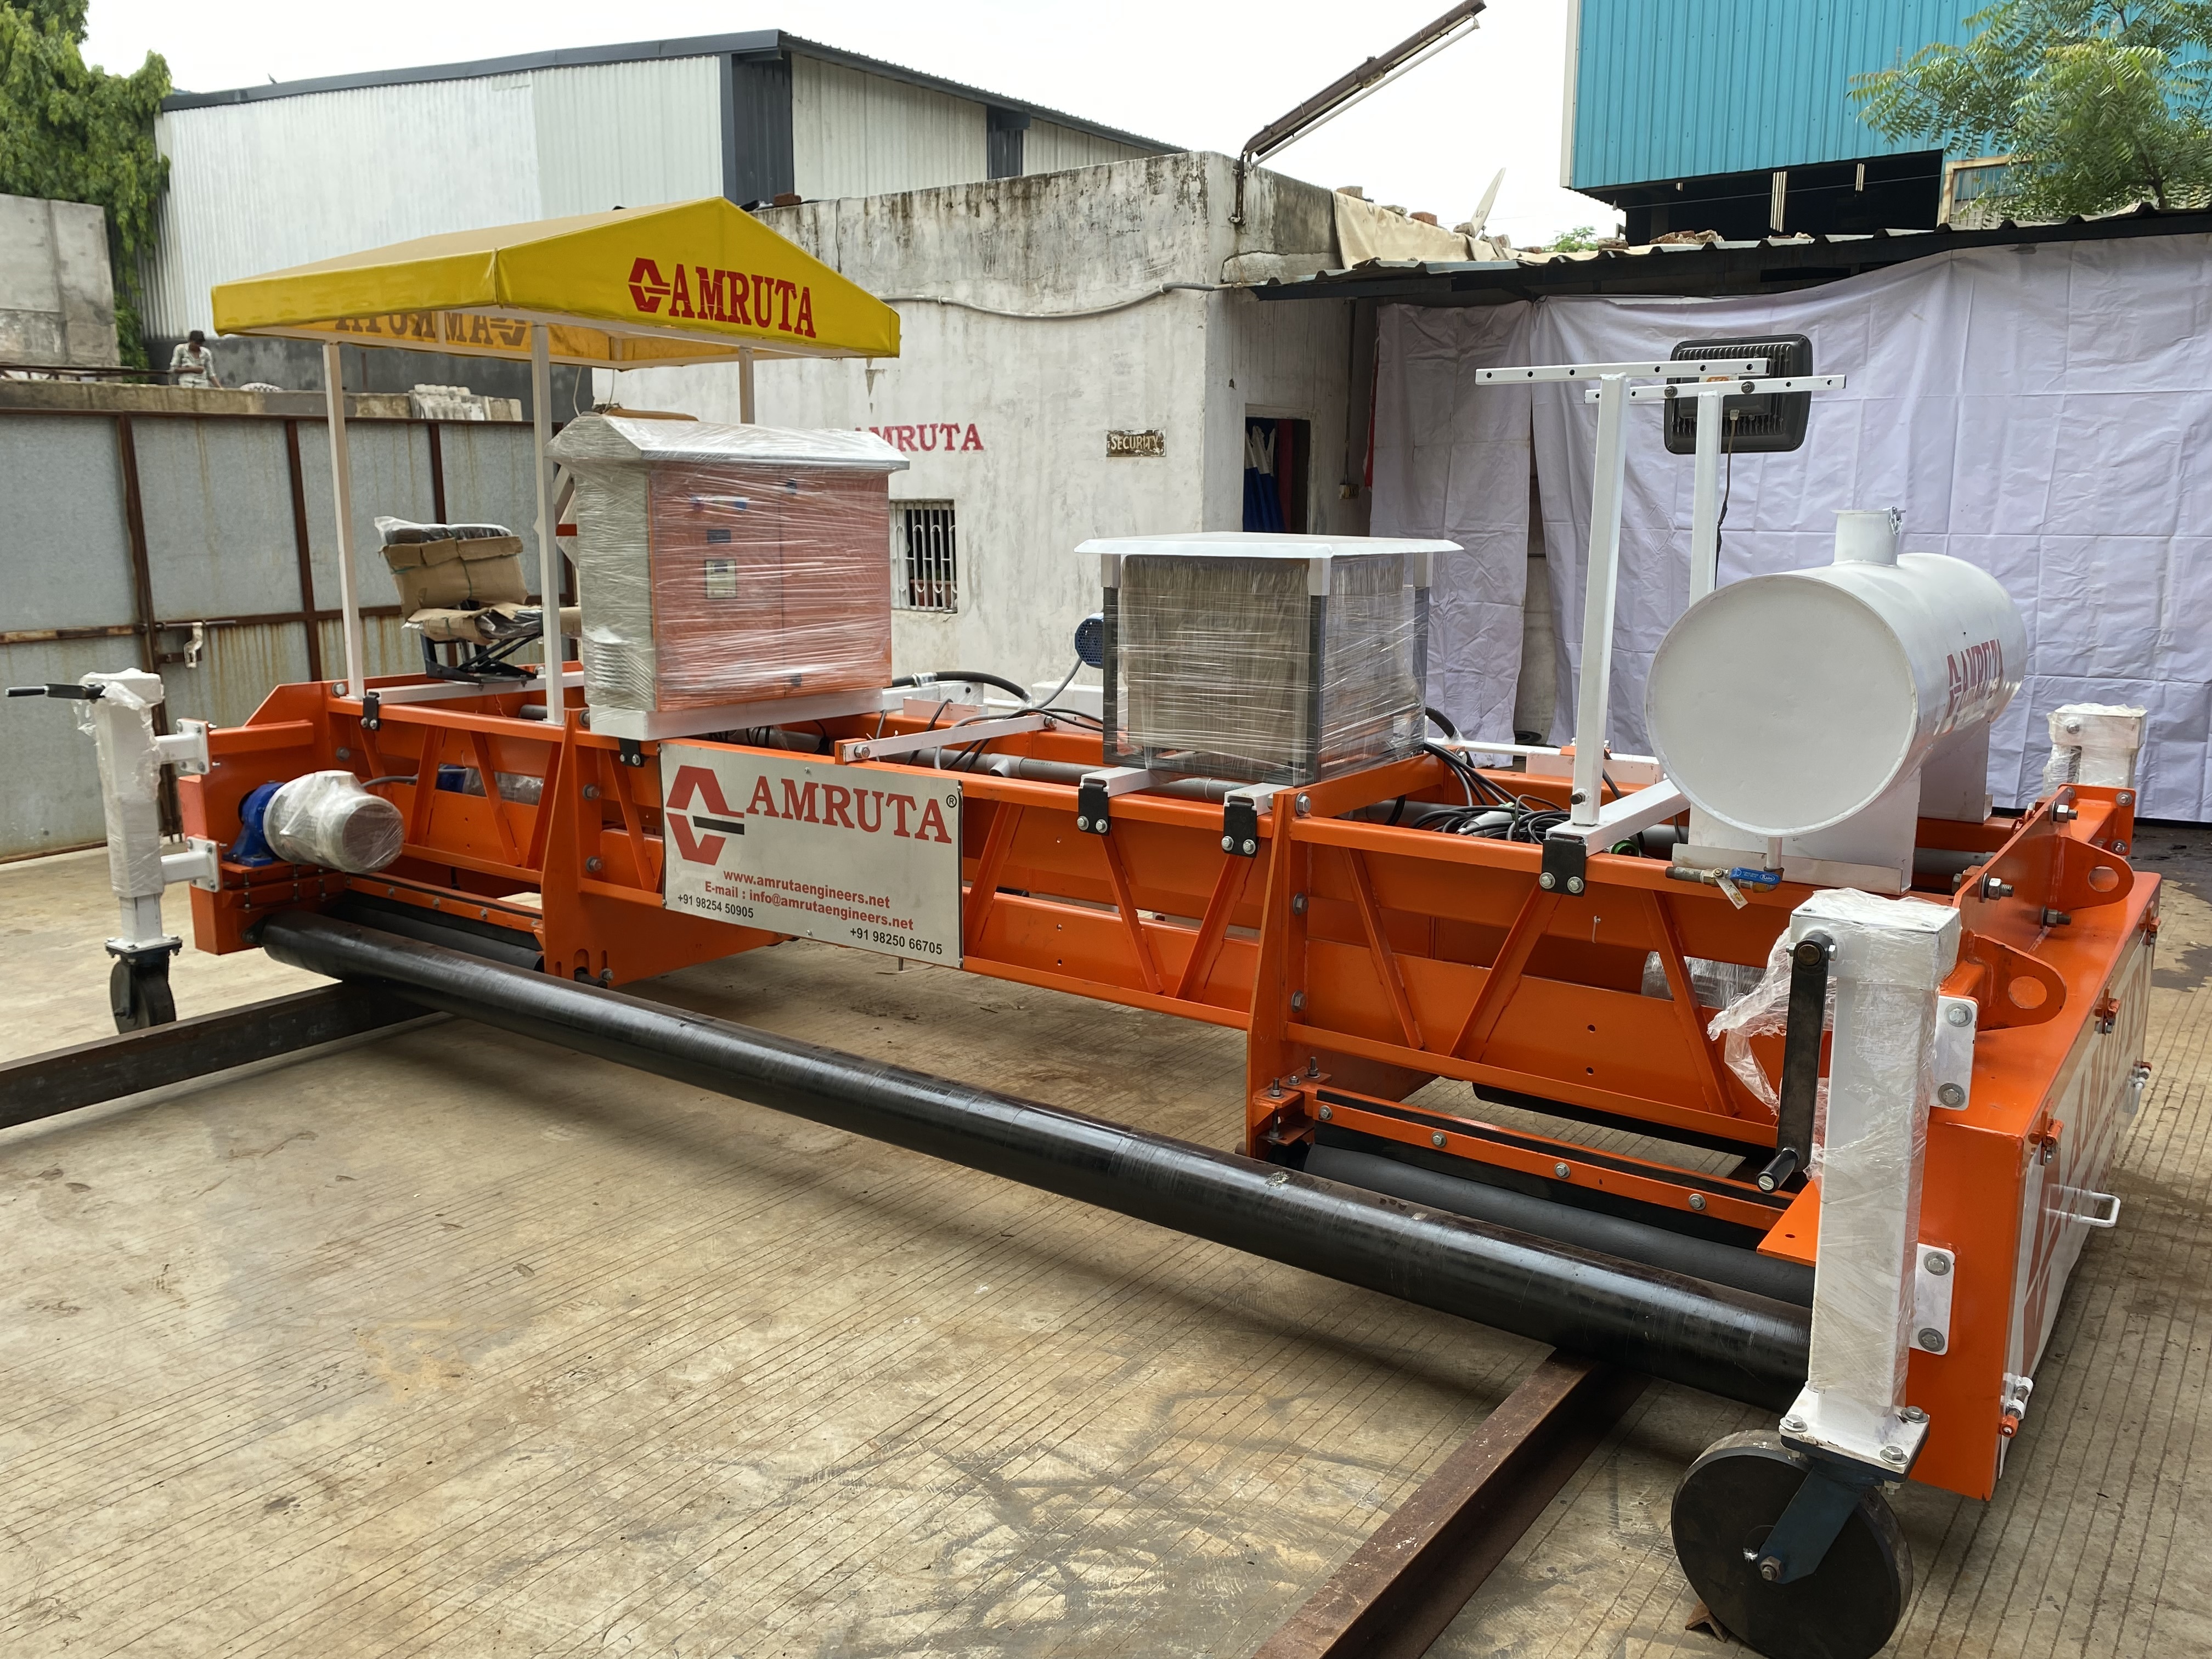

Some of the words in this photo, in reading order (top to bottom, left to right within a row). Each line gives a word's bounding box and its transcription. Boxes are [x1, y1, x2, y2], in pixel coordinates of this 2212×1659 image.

[668, 263, 816, 338] AMRUTA
[1110, 435, 1158, 450] SECURITY
[678, 894, 693, 905] +91
[696, 896, 722, 912] 98254
[725, 903, 754, 918] 50905
[705, 881, 738, 898] E-mail
[749, 889, 913, 930] info@amrutaengineers.net
[723, 870, 890, 909] www.amrutaengineers.net
[850, 927, 868, 940] +91
[873, 930, 905, 947] 98250
[909, 938, 943, 955] 66705
